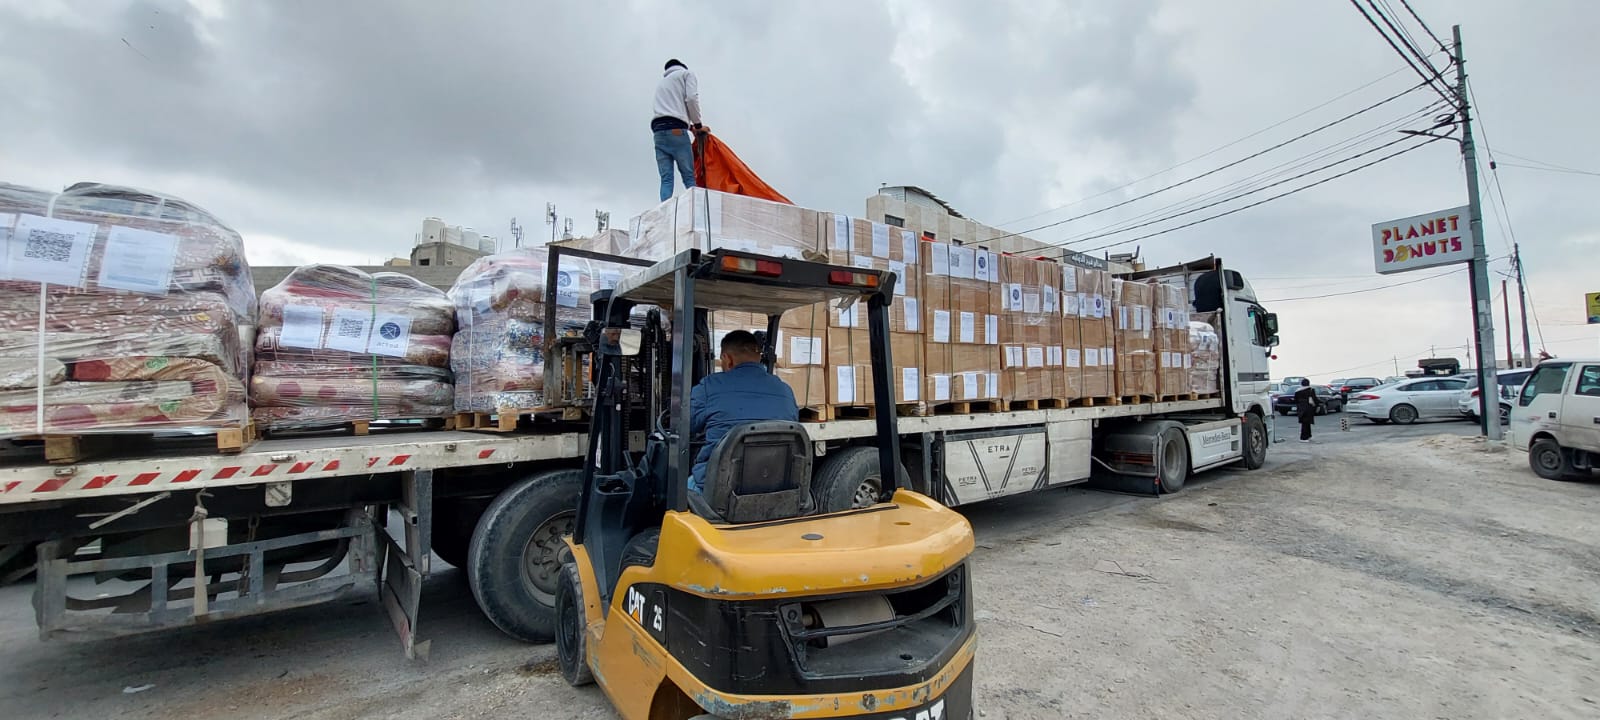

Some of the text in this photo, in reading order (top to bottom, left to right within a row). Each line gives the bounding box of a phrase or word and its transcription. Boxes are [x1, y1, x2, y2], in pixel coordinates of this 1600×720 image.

[1382, 216, 1459, 245] PLANET
[1384, 237, 1462, 263] DONUTS
[987, 445, 1011, 454] ETRA
[628, 586, 646, 625] CAT
[653, 604, 663, 632] 25
